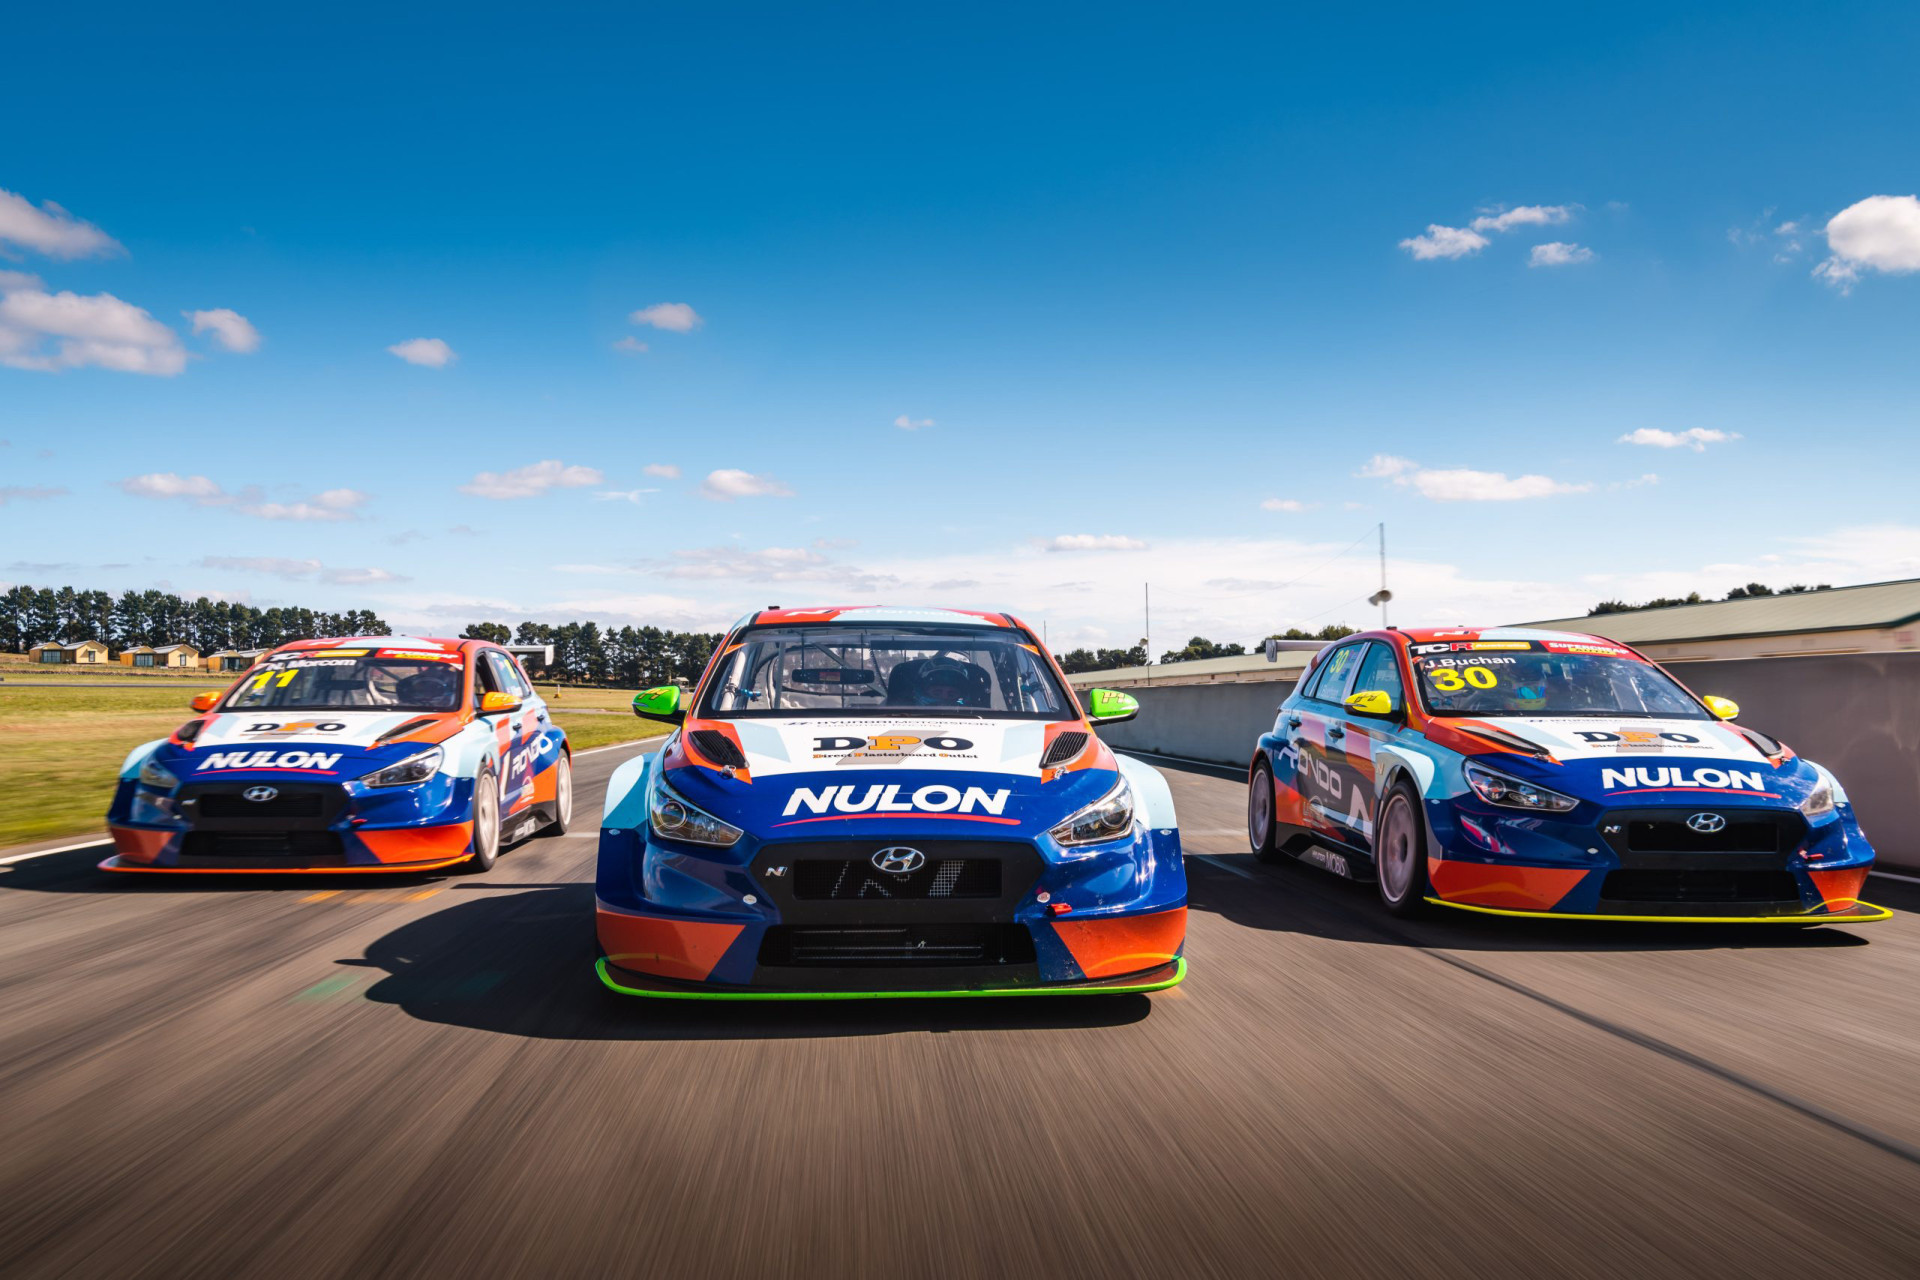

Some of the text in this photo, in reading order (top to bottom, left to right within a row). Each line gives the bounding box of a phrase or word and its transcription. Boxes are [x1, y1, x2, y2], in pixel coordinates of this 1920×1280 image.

[1410, 642, 1473, 654] TCR
[1329, 650, 1350, 673] 30
[1425, 655, 1516, 669] J.Buchan
[252, 669, 299, 689] 11
[1430, 666, 1497, 691] 30
[244, 722, 346, 732] DPO
[813, 736, 974, 751] DPO
[1572, 731, 1700, 744] DPO
[196, 751, 343, 770] NULON
[1278, 746, 1342, 799] RONDO
[1602, 767, 1766, 791] NULON
[781, 784, 1012, 816] NULON
